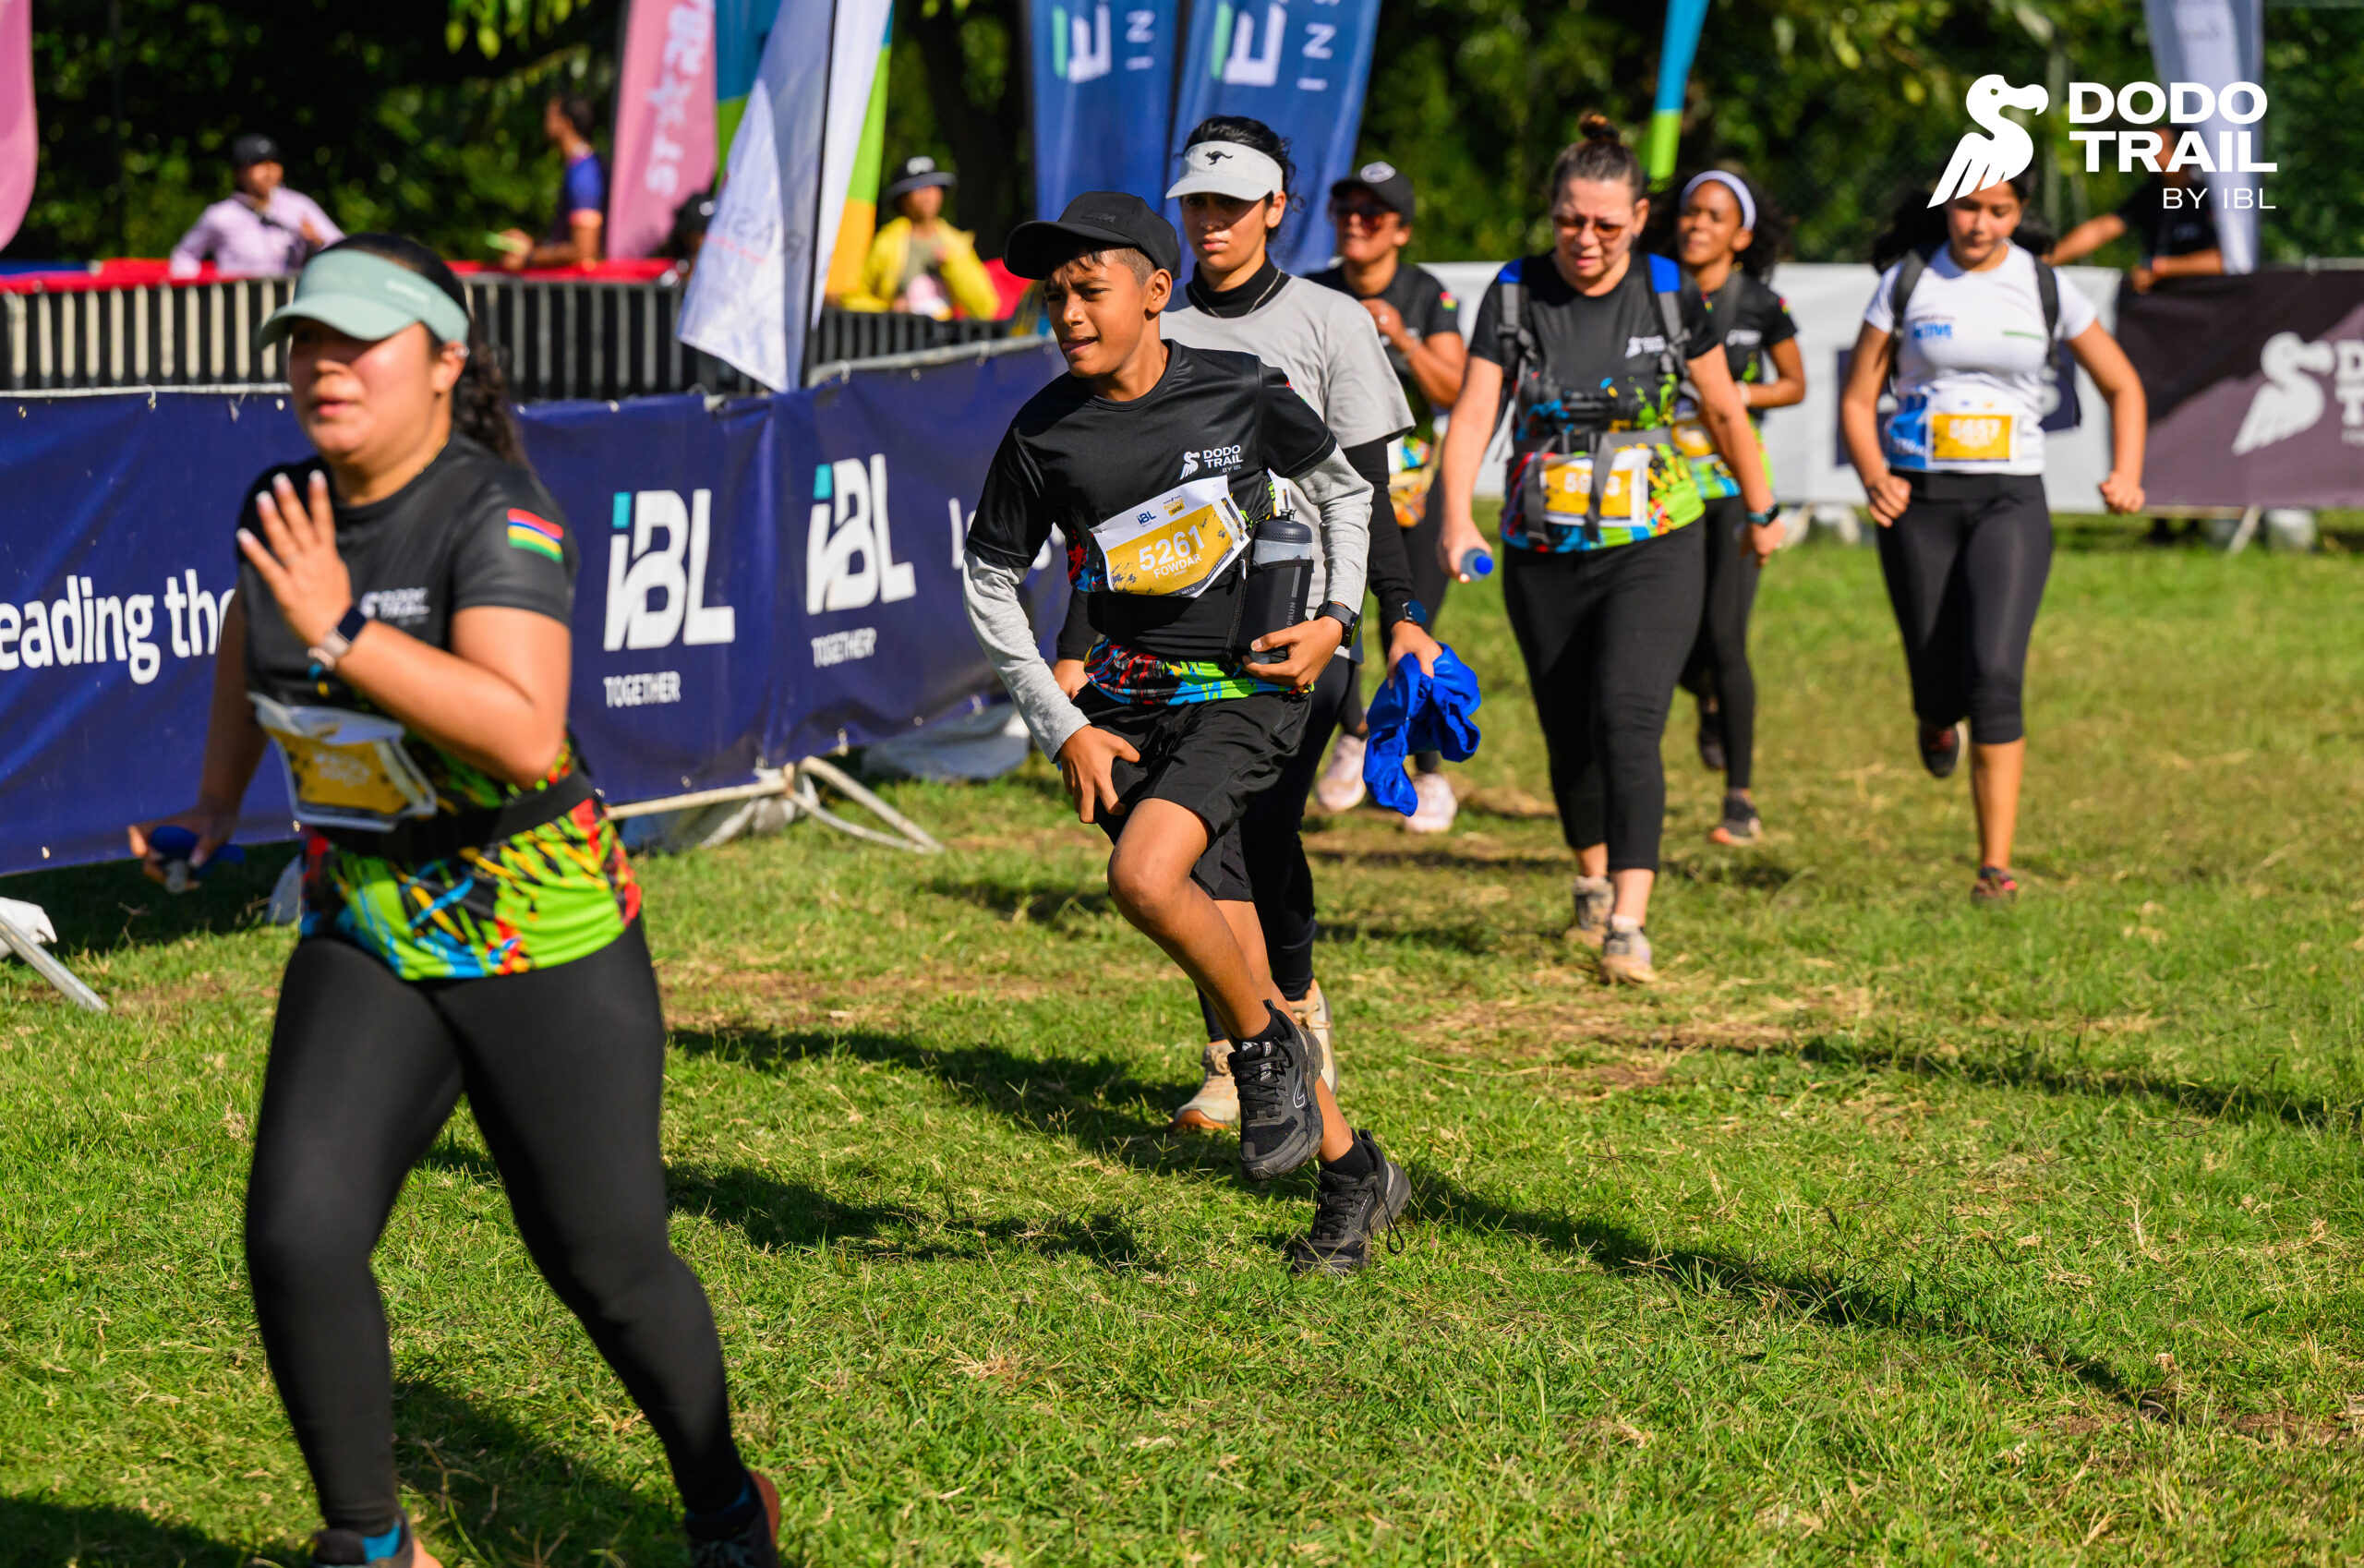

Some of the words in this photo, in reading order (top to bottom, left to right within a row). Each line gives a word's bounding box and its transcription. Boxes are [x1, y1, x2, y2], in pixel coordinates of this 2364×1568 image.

[1203, 444, 1241, 459] DODO
[1204, 454, 1244, 468] TRAIL
[1139, 525, 1205, 572] 5261
[1153, 553, 1202, 578] FOWDAR
[1285, 601, 1297, 629] PRUN
[811, 627, 876, 668] TOGETHER
[603, 670, 681, 708] TOGETHER
